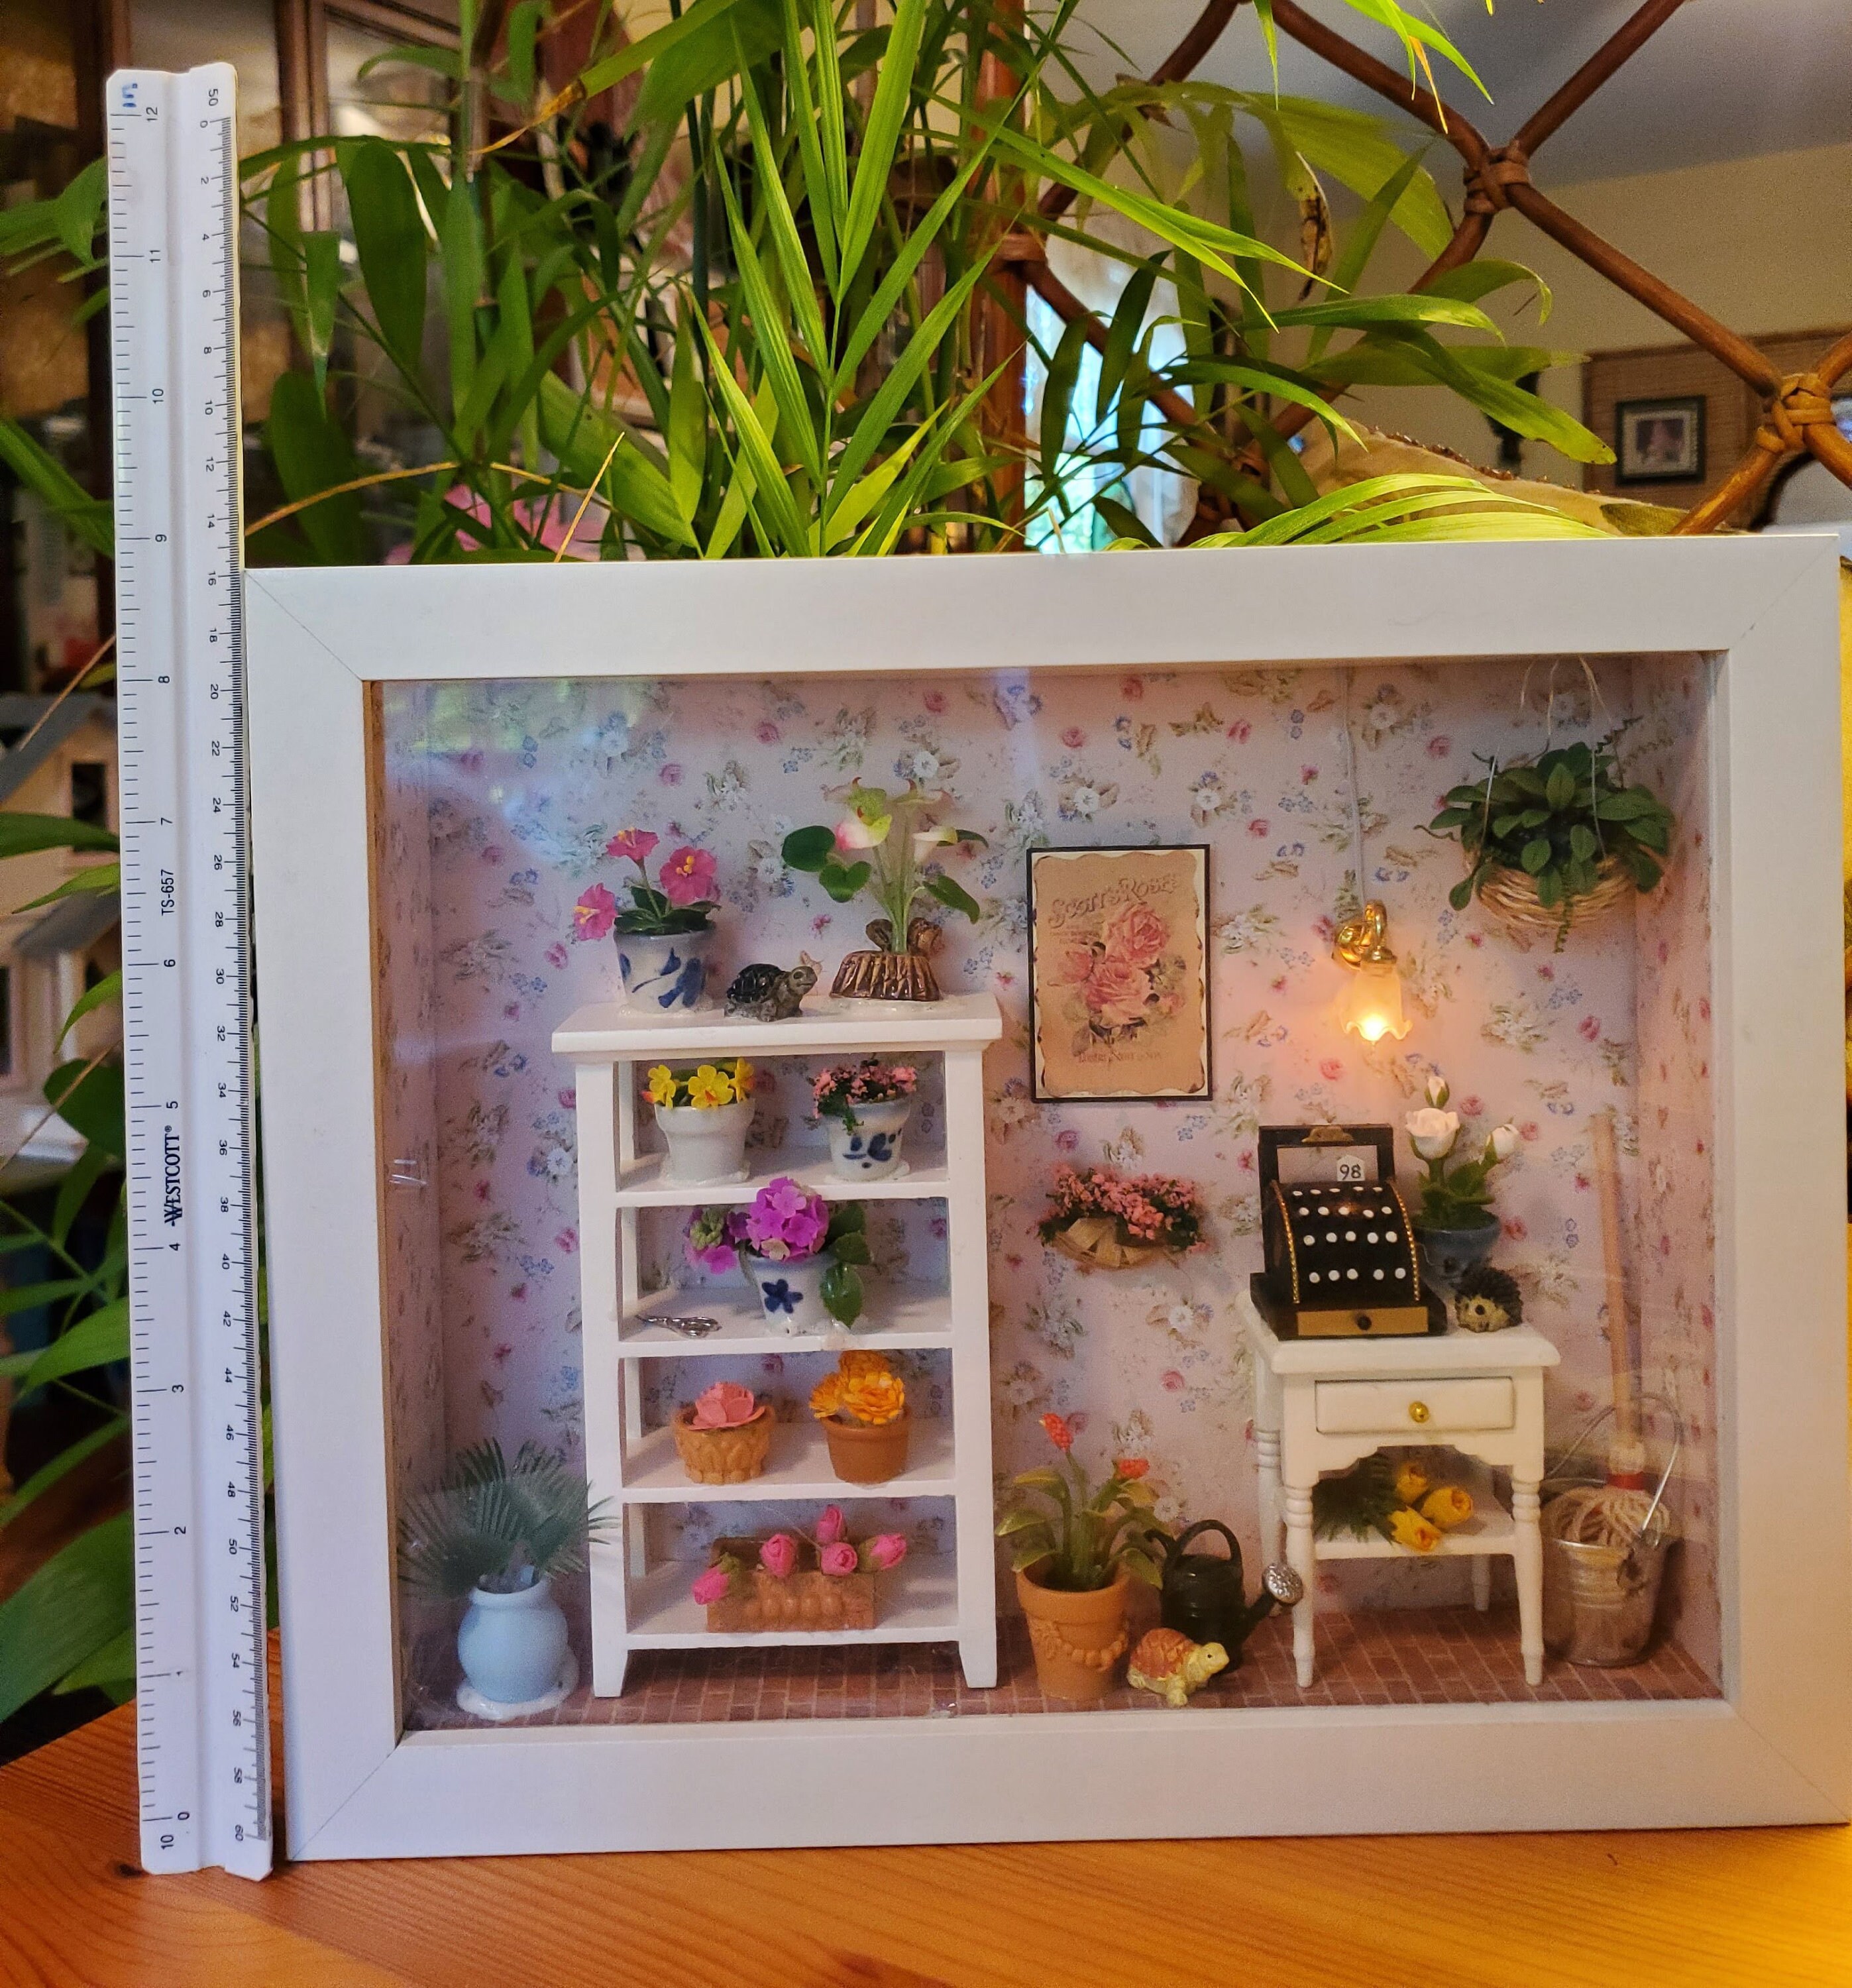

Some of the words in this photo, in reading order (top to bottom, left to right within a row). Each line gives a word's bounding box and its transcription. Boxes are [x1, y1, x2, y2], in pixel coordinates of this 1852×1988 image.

[209, 89, 218, 106] 50
[146, 107, 158, 121] 12
[149, 250, 161, 263] 11
[152, 388, 164, 404] 10
[205, 400, 213, 415] 10
[205, 457, 214, 472] 12
[207, 514, 215, 528] 14
[208, 571, 216, 586] 16
[209, 628, 217, 643] 18
[210, 684, 218, 699] 20
[211, 741, 219, 756] 22
[213, 798, 221, 813] 24
[214, 854, 222, 870] 26
[160, 869, 174, 916] TS-657
[215, 911, 223, 928] 28
[164, 959, 176, 967] 6
[216, 968, 224, 984] 30
[217, 1025, 225, 1042] 32
[218, 1083, 226, 1098] 34
[219, 1140, 227, 1155] 36
[1340, 1164, 1362, 1180] 98
[220, 1197, 229, 1212] 38
[169, 1242, 181, 1251] 4
[221, 1253, 230, 1270] 40
[223, 1311, 231, 1327] 42
[225, 1368, 233, 1383] 44
[172, 1384, 184, 1393] 3
[226, 1425, 234, 1441] 46
[227, 1482, 235, 1497] 48
[174, 1526, 186, 1535] 2
[229, 1538, 237, 1555] 50
[230, 1596, 239, 1612] 52
[232, 1653, 240, 1668] 54
[233, 1709, 241, 1726] 56
[178, 1812, 190, 1820] 0
[235, 1824, 243, 1842] 60
[160, 1834, 174, 1850] 10
